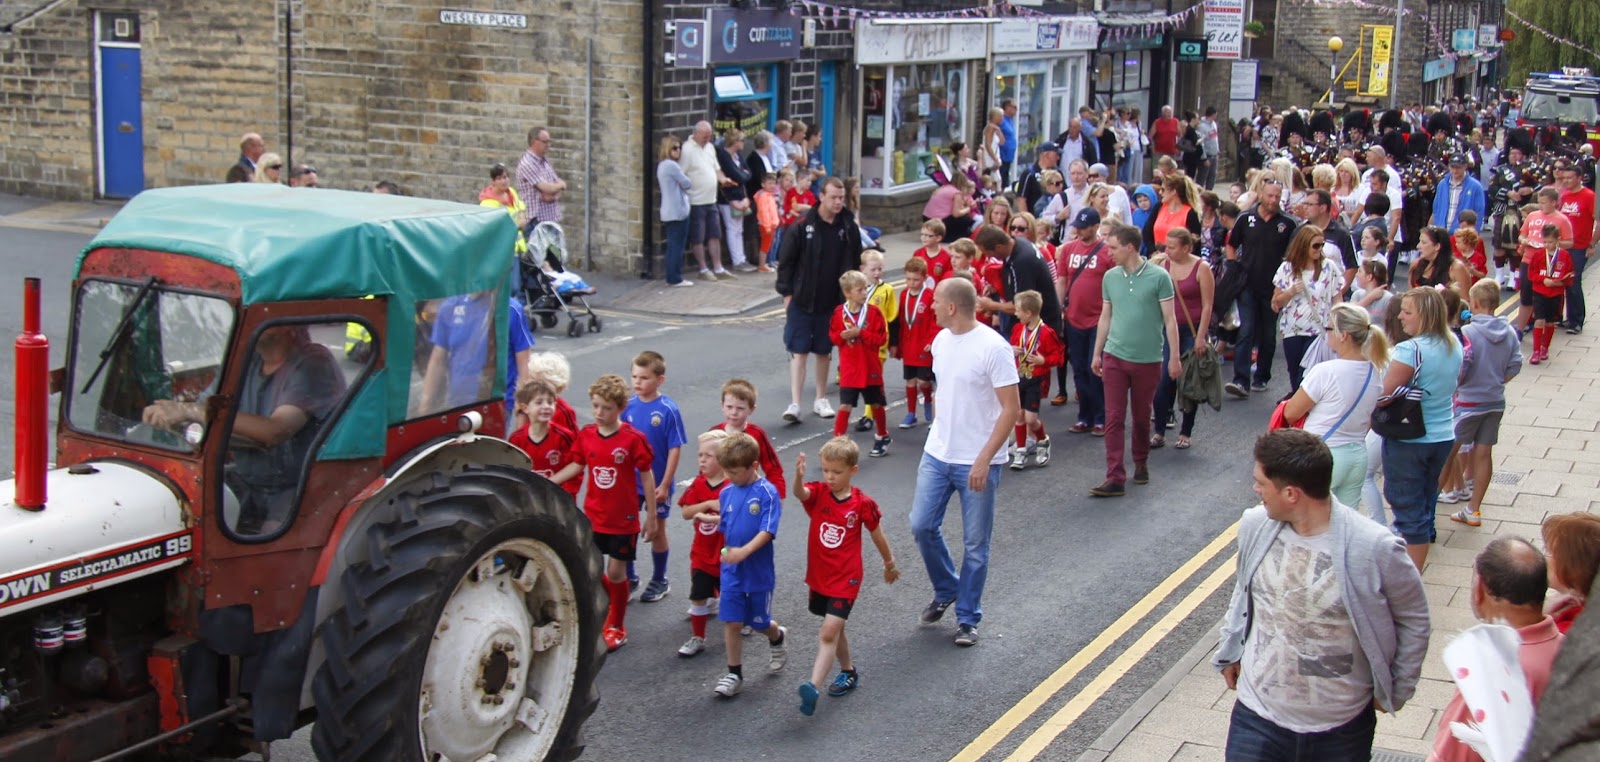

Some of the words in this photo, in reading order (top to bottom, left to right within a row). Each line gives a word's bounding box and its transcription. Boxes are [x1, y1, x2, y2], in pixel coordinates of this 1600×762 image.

[443, 13, 484, 24] WESLEY
[489, 15, 522, 26] PLACE
[60, 546, 161, 584] SELECTAMATIC
[166, 535, 192, 556] 99
